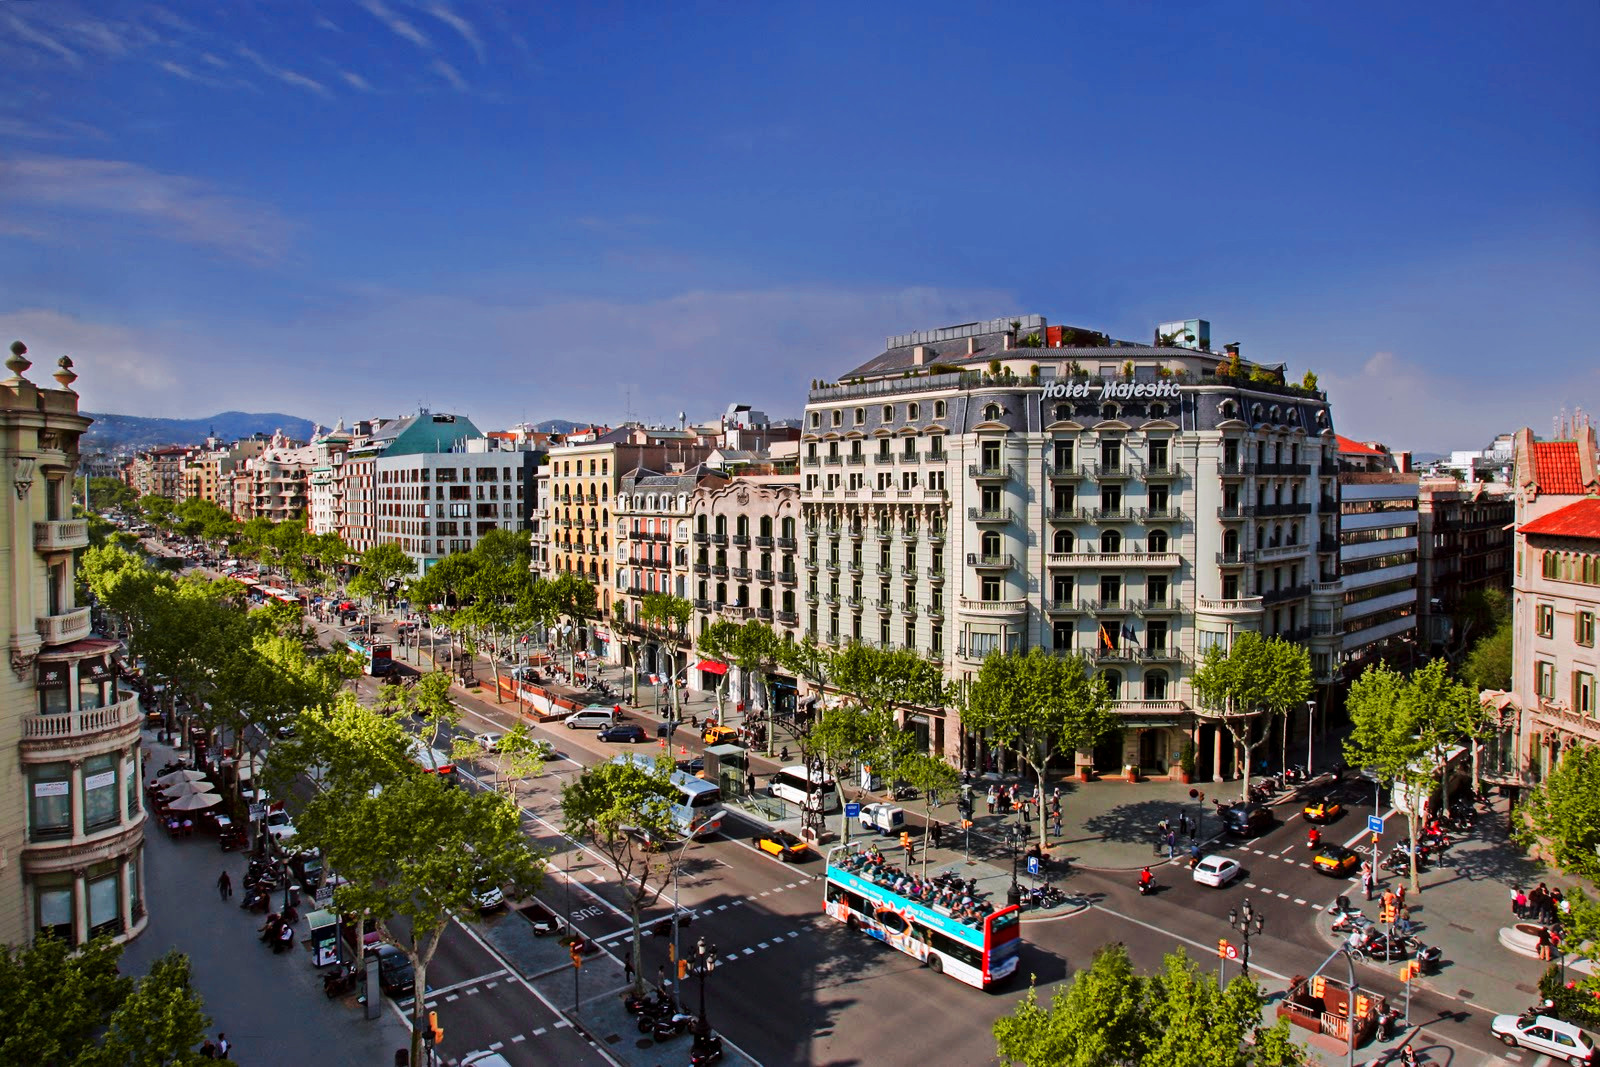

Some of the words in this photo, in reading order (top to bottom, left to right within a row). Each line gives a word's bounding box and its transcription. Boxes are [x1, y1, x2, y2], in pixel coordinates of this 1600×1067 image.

[1040, 380, 1090, 401] Hotel
[1098, 379, 1181, 400] Majestic
[1353, 844, 1383, 857] BUS
[1030, 857, 1036, 866] P
[570, 905, 604, 921] BUS
